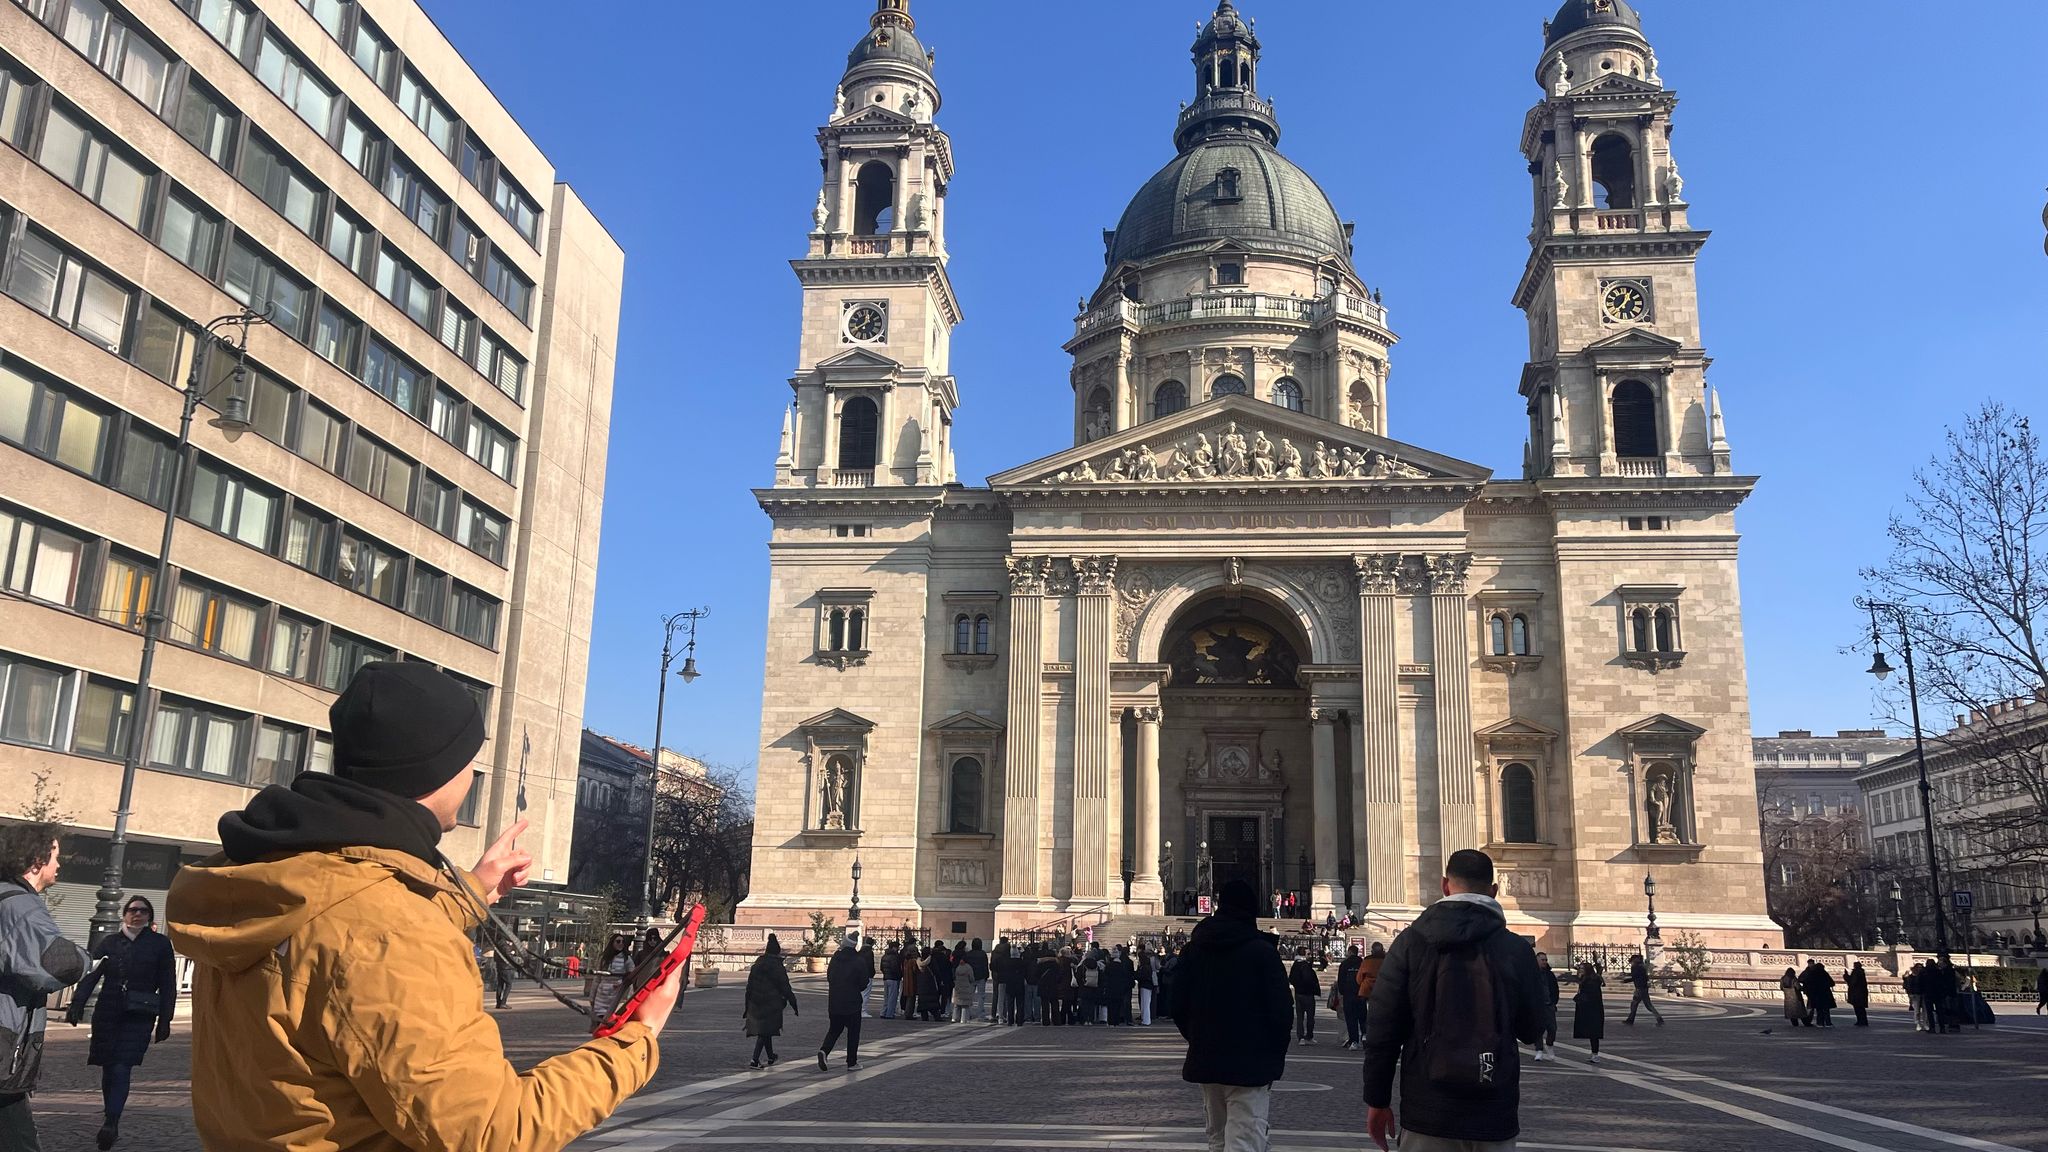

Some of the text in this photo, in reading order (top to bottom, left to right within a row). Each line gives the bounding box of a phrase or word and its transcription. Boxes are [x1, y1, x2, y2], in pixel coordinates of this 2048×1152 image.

[1100, 514, 1372, 528] EGO SUM VIA VERITAS ET VITA
[1483, 1052, 1494, 1082] EA7
